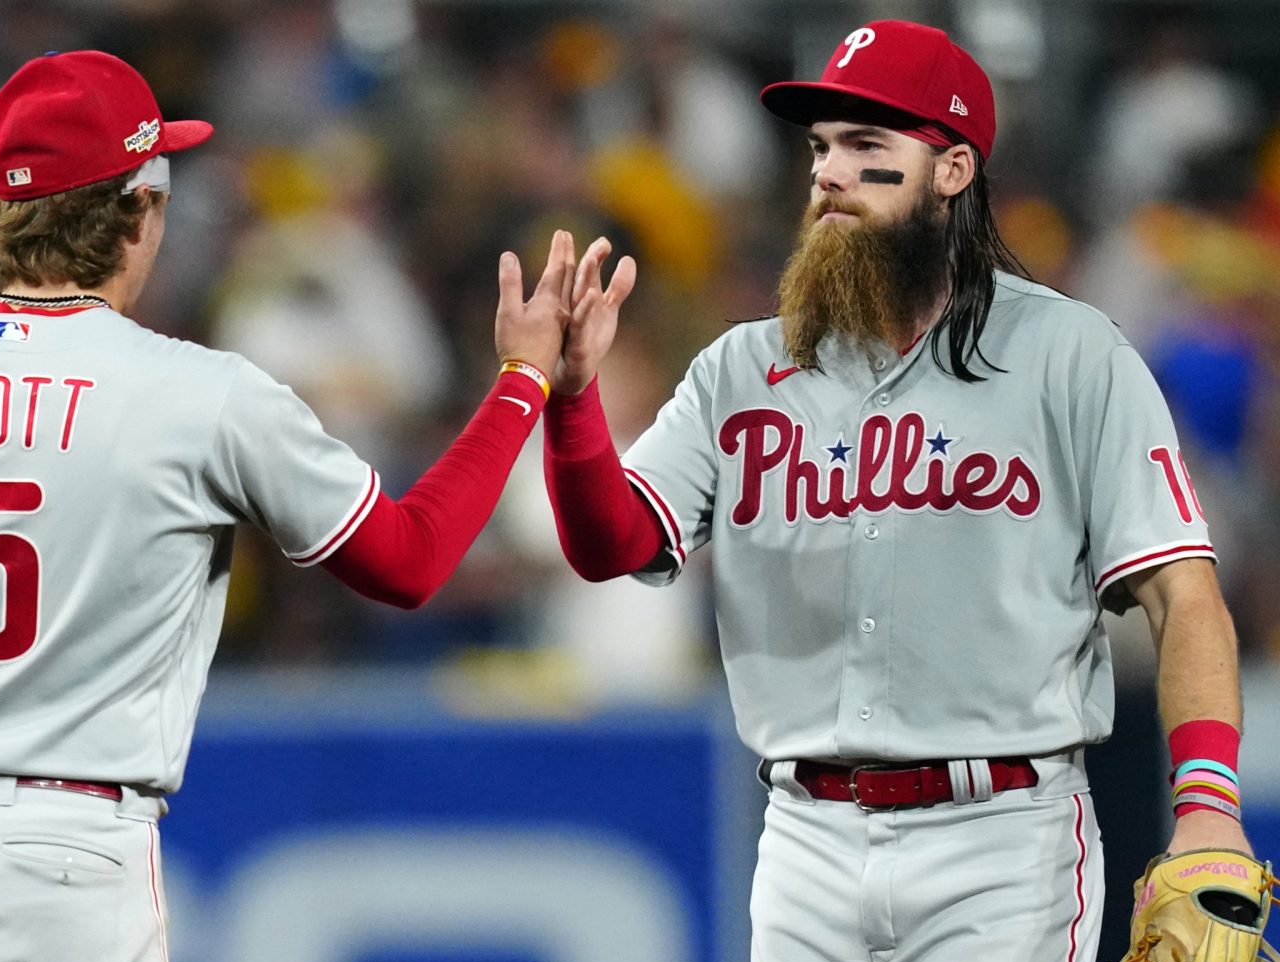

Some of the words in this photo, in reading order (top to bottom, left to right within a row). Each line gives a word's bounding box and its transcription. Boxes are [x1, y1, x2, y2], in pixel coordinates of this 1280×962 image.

[836, 27, 876, 69] P
[718, 408, 1042, 529] Phillies
[1146, 444, 1209, 526] 1
